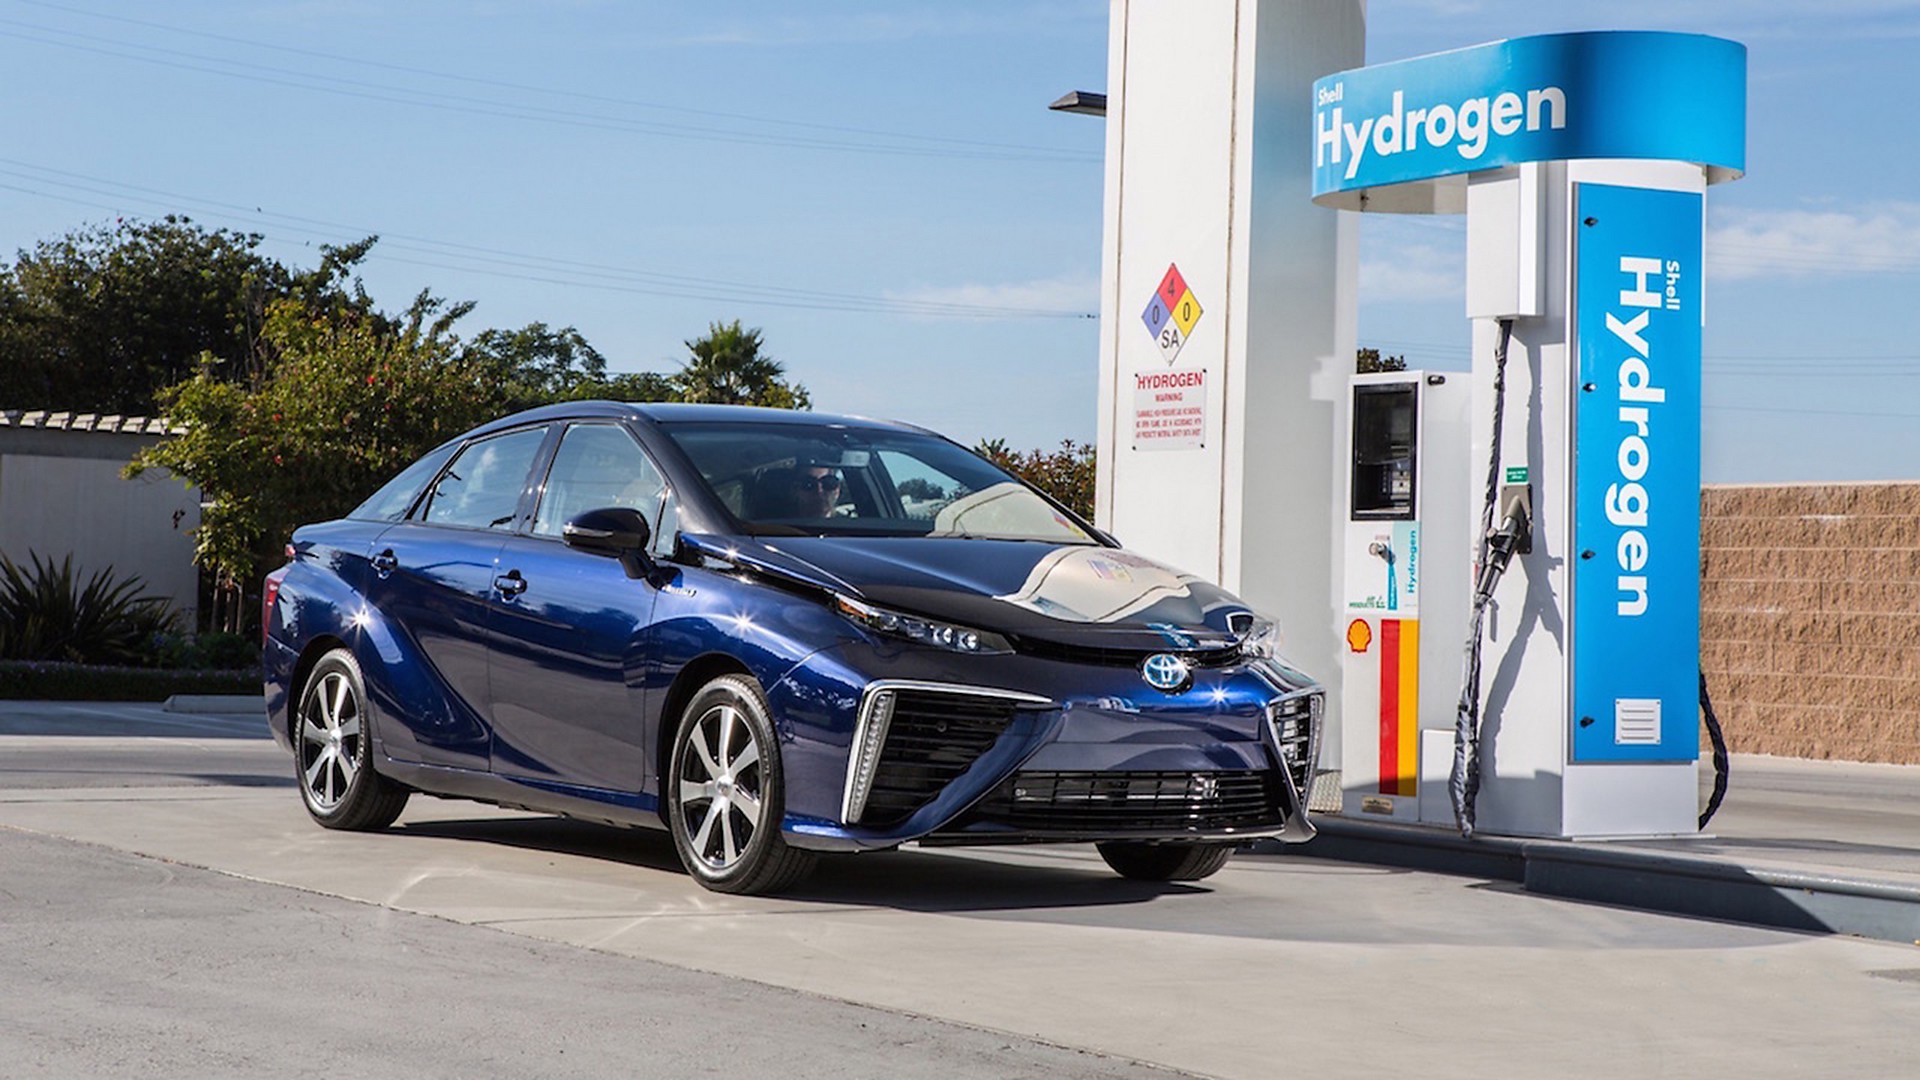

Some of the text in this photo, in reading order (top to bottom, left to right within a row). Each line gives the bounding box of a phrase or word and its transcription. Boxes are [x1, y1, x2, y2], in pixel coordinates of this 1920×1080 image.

[1318, 83, 1343, 106] Shell
[1317, 86, 1566, 179] Hydrogen
[1168, 279, 1175, 297] 4
[1666, 261, 1680, 310] Shell
[1152, 304, 1160, 325] 0
[1183, 301, 1191, 322] 0
[1161, 329, 1180, 349] SA
[1137, 372, 1203, 389] HYDROGEN
[1605, 256, 1665, 616] Hydrogen
[1407, 530, 1417, 593] Hydrogen
